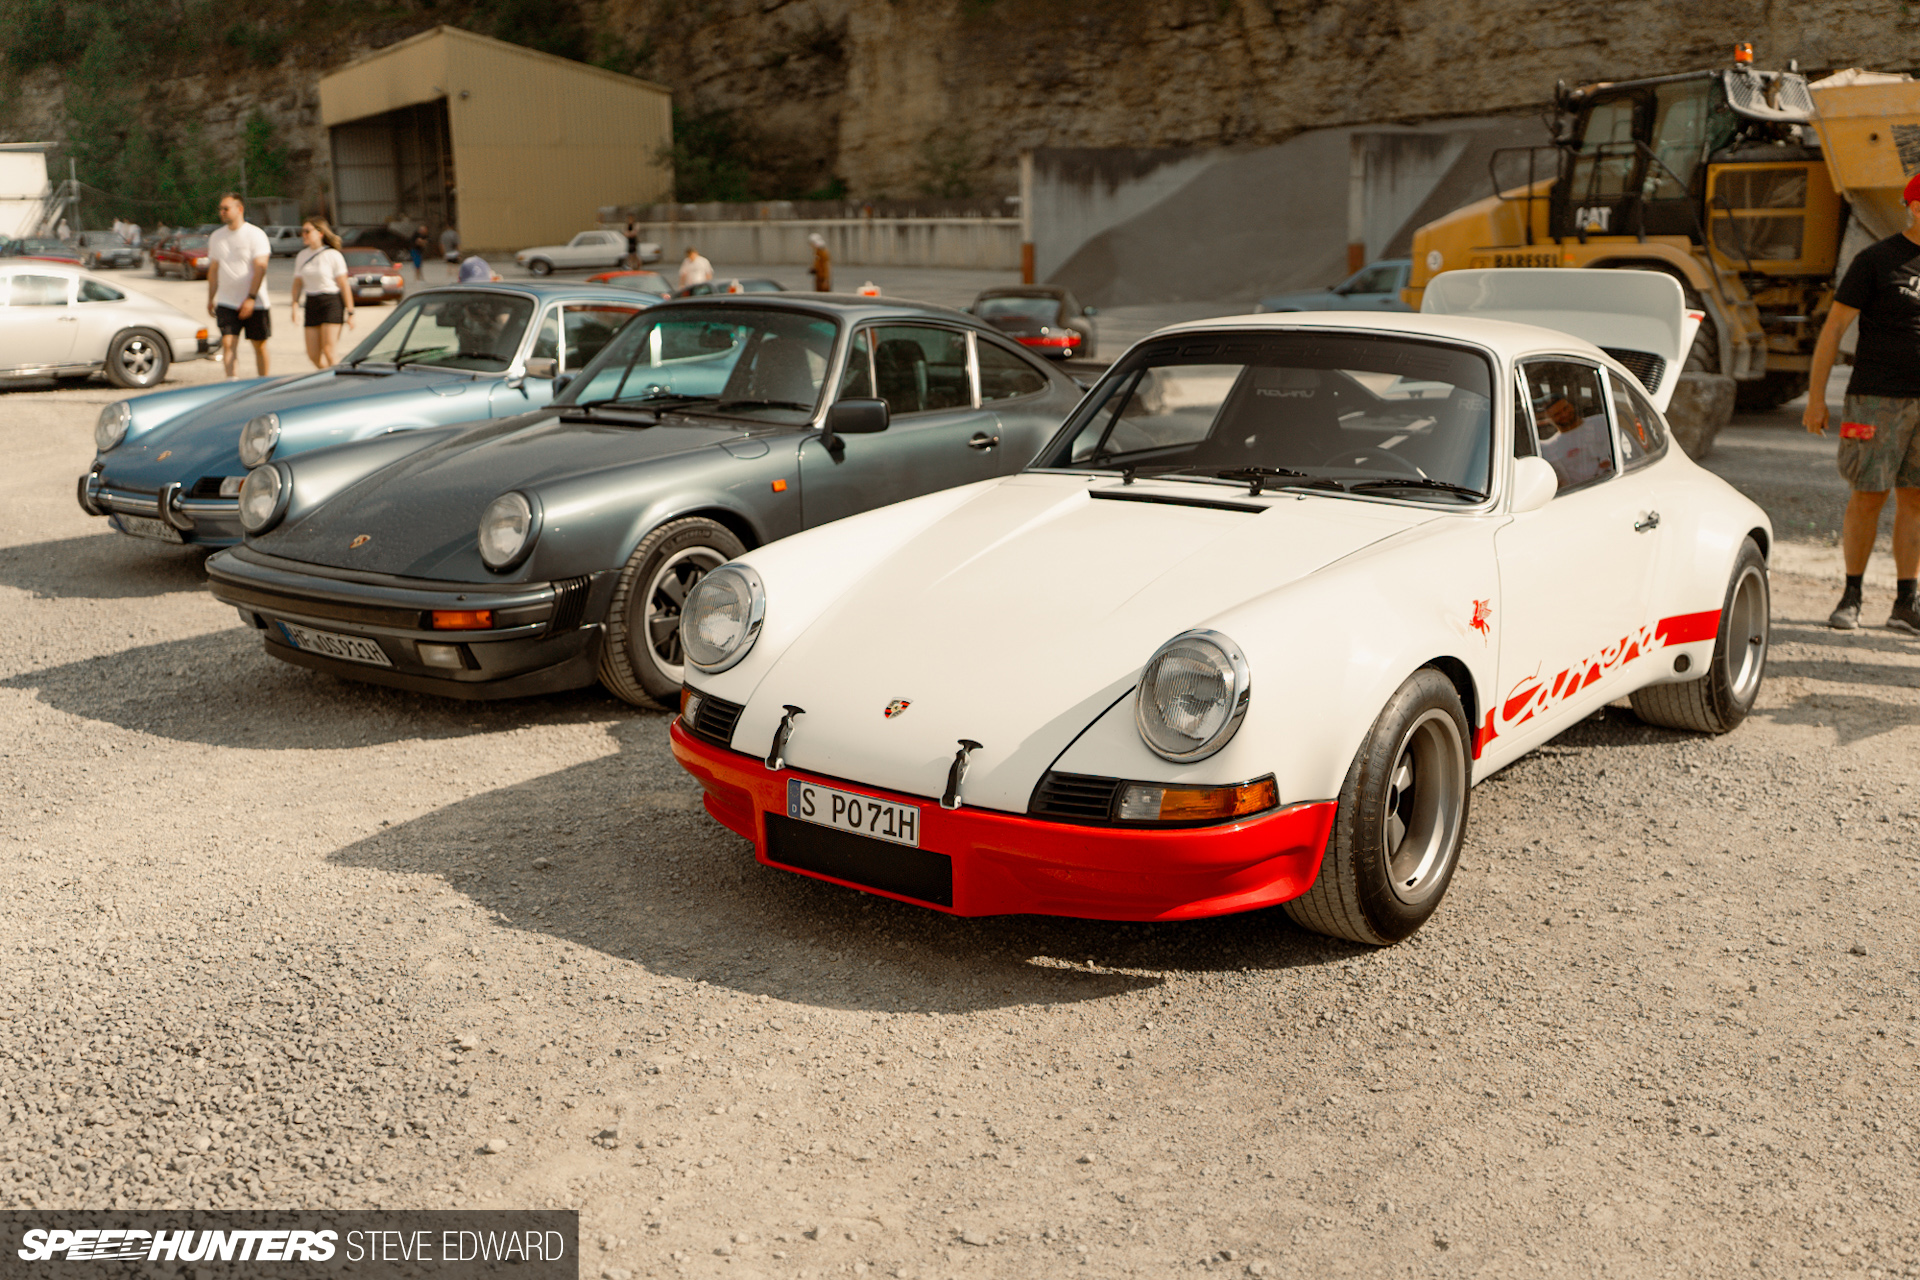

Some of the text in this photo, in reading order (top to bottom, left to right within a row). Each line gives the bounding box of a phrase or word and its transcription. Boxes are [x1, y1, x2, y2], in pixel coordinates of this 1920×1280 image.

[1575, 206, 1612, 232] CAT
[1495, 253, 1559, 268] BARESEL
[802, 788, 816, 817] S
